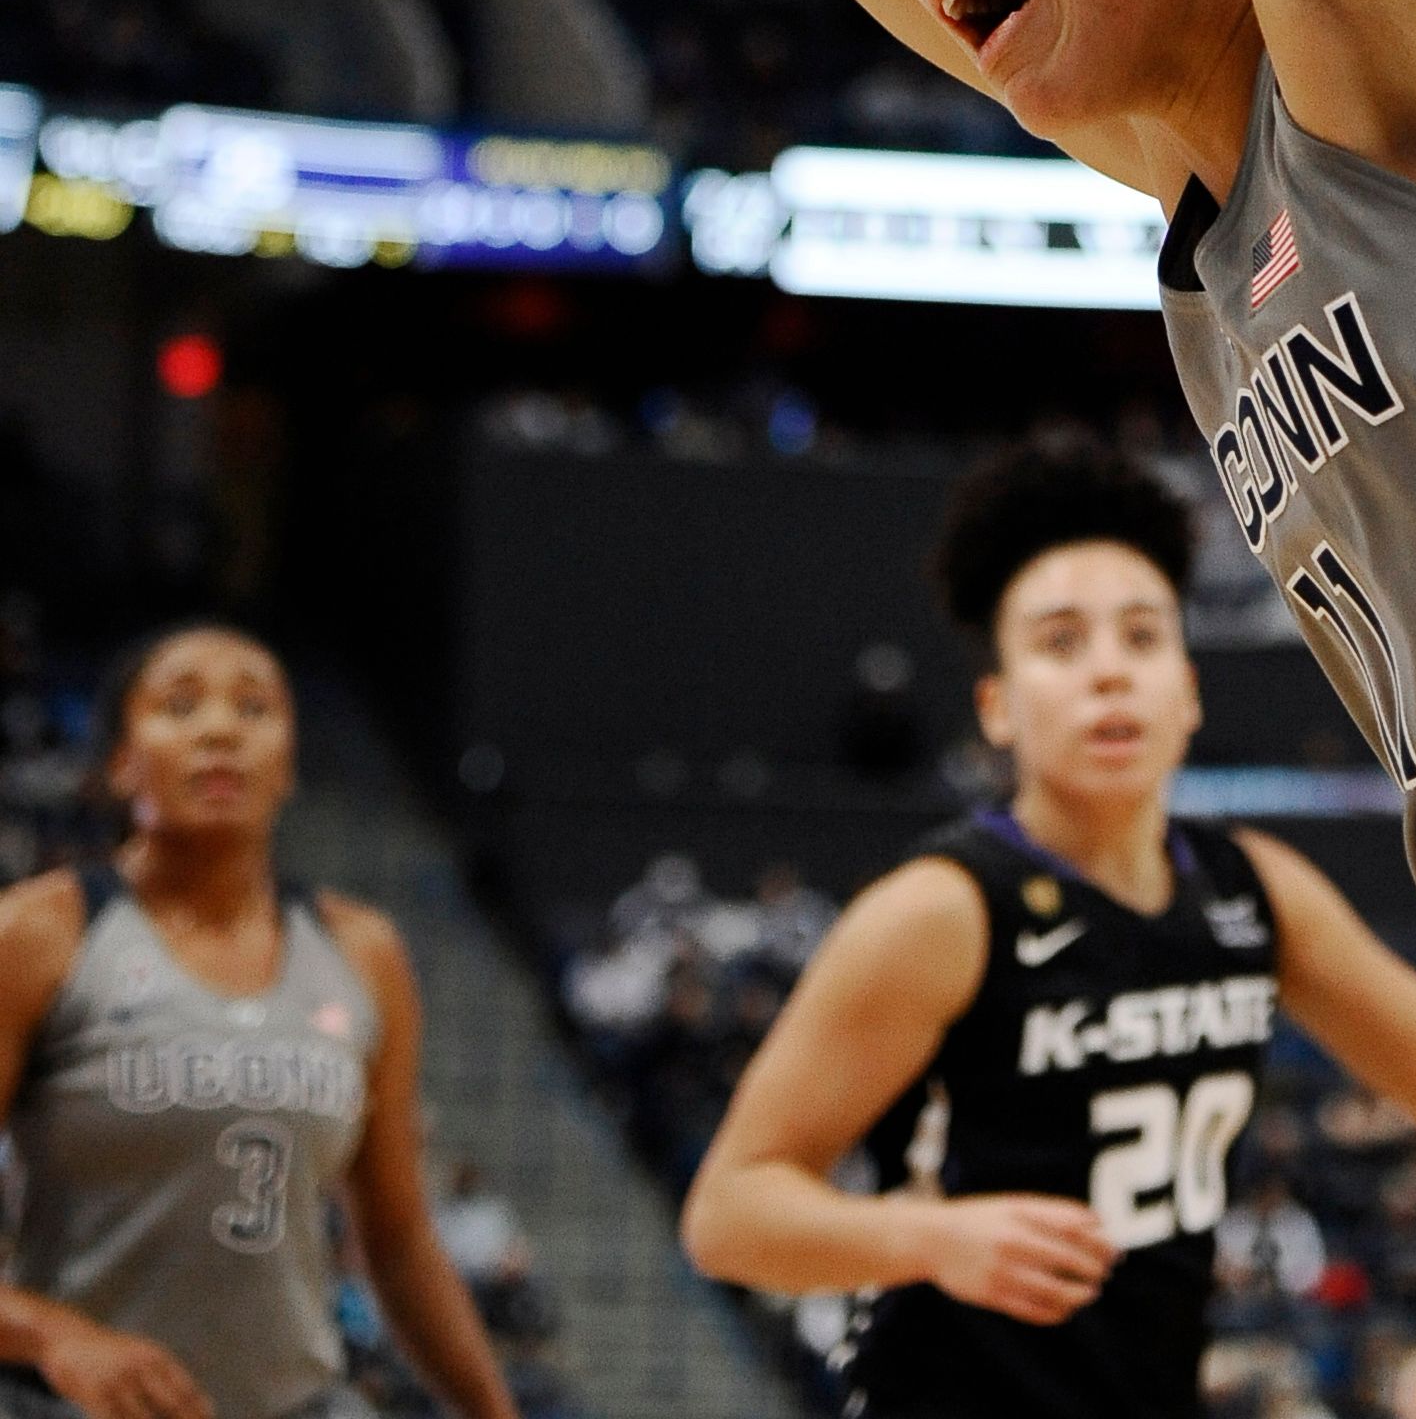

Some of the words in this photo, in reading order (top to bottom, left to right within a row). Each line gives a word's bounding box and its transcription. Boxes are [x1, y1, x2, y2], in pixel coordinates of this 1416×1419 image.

[1018, 973, 1278, 1078] K-STATE
[210, 1116, 294, 1255] 3
[1088, 1069, 1258, 1253] 20
